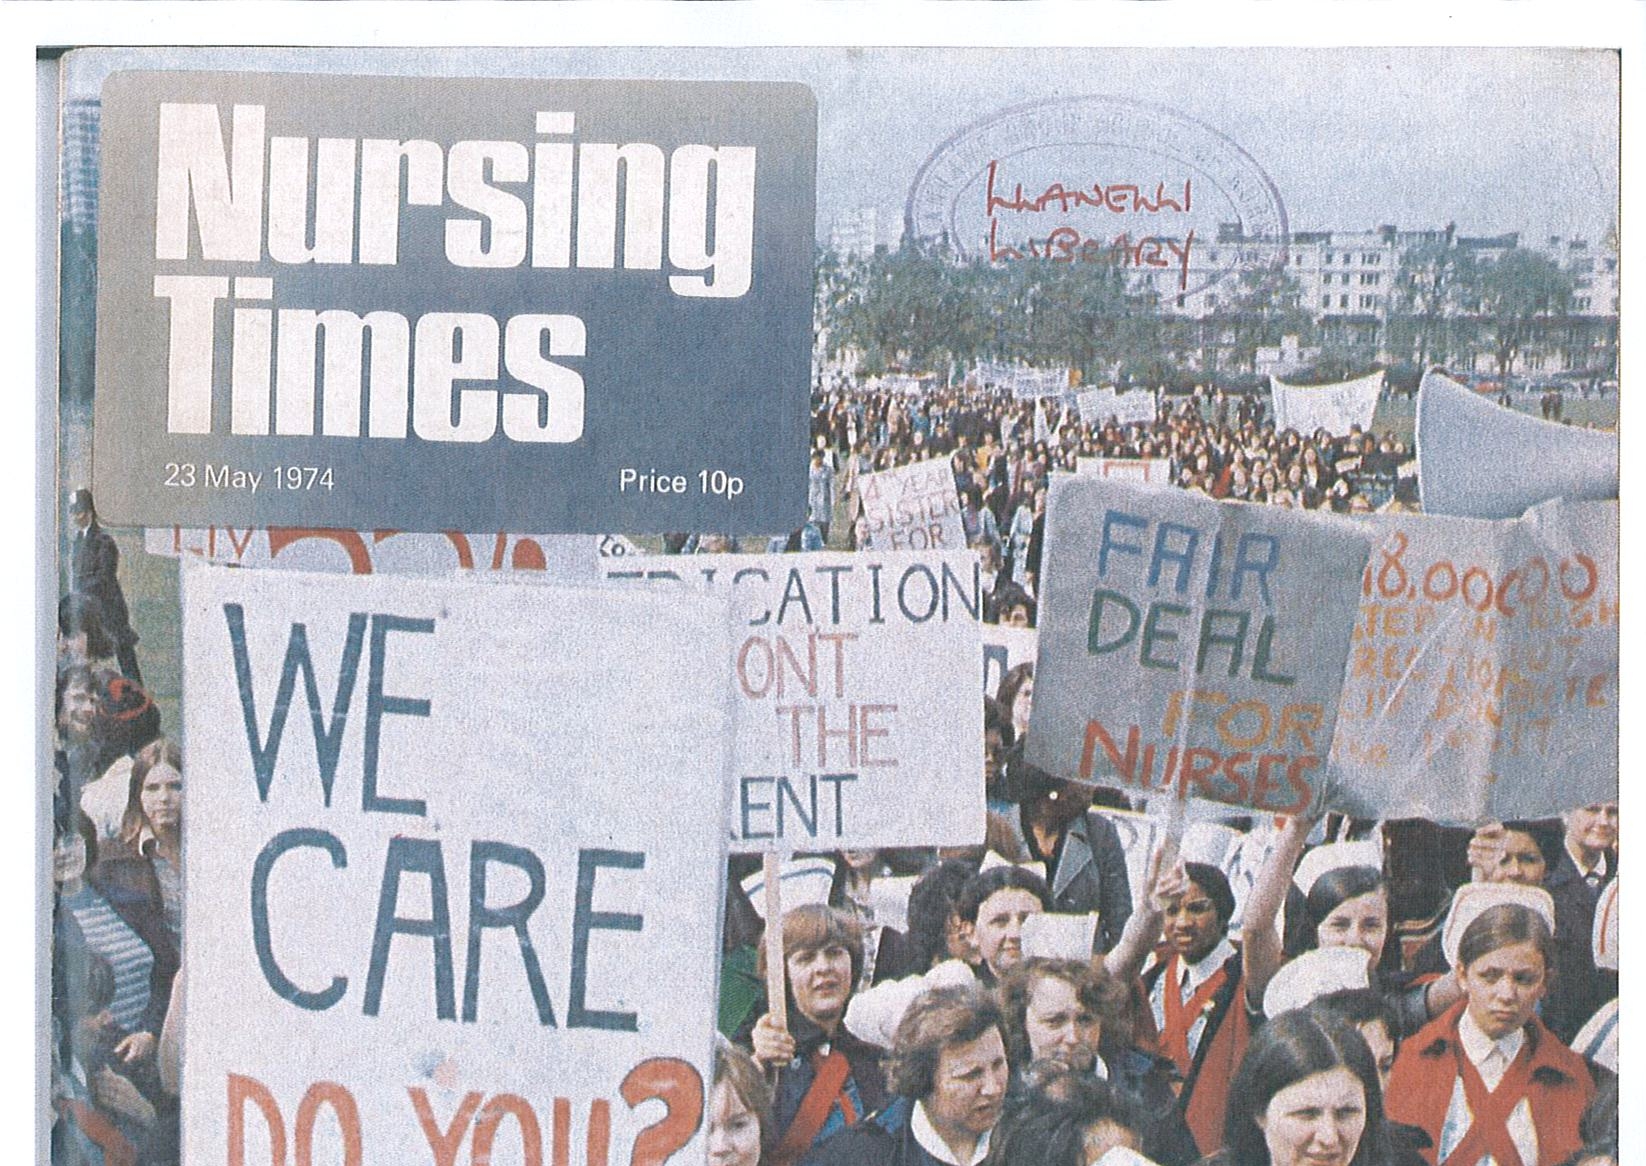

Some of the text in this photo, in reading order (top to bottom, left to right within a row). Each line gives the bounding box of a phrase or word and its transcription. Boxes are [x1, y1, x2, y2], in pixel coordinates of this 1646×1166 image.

[153, 102, 757, 299] Nursing
[153, 274, 587, 444] Times
[163, 463, 335, 494] 23 May 1974
[619, 468, 744, 500] Price 10p
[1100, 509, 1280, 606] FAIR
[1088, 589, 1295, 686] DEAL
[223, 602, 436, 817] WE
[775, 704, 899, 768] THE
[1163, 690, 1324, 750] FOR
[730, 773, 859, 841] ENT
[1079, 719, 1321, 815] NURSES
[250, 827, 646, 1032] CARE
